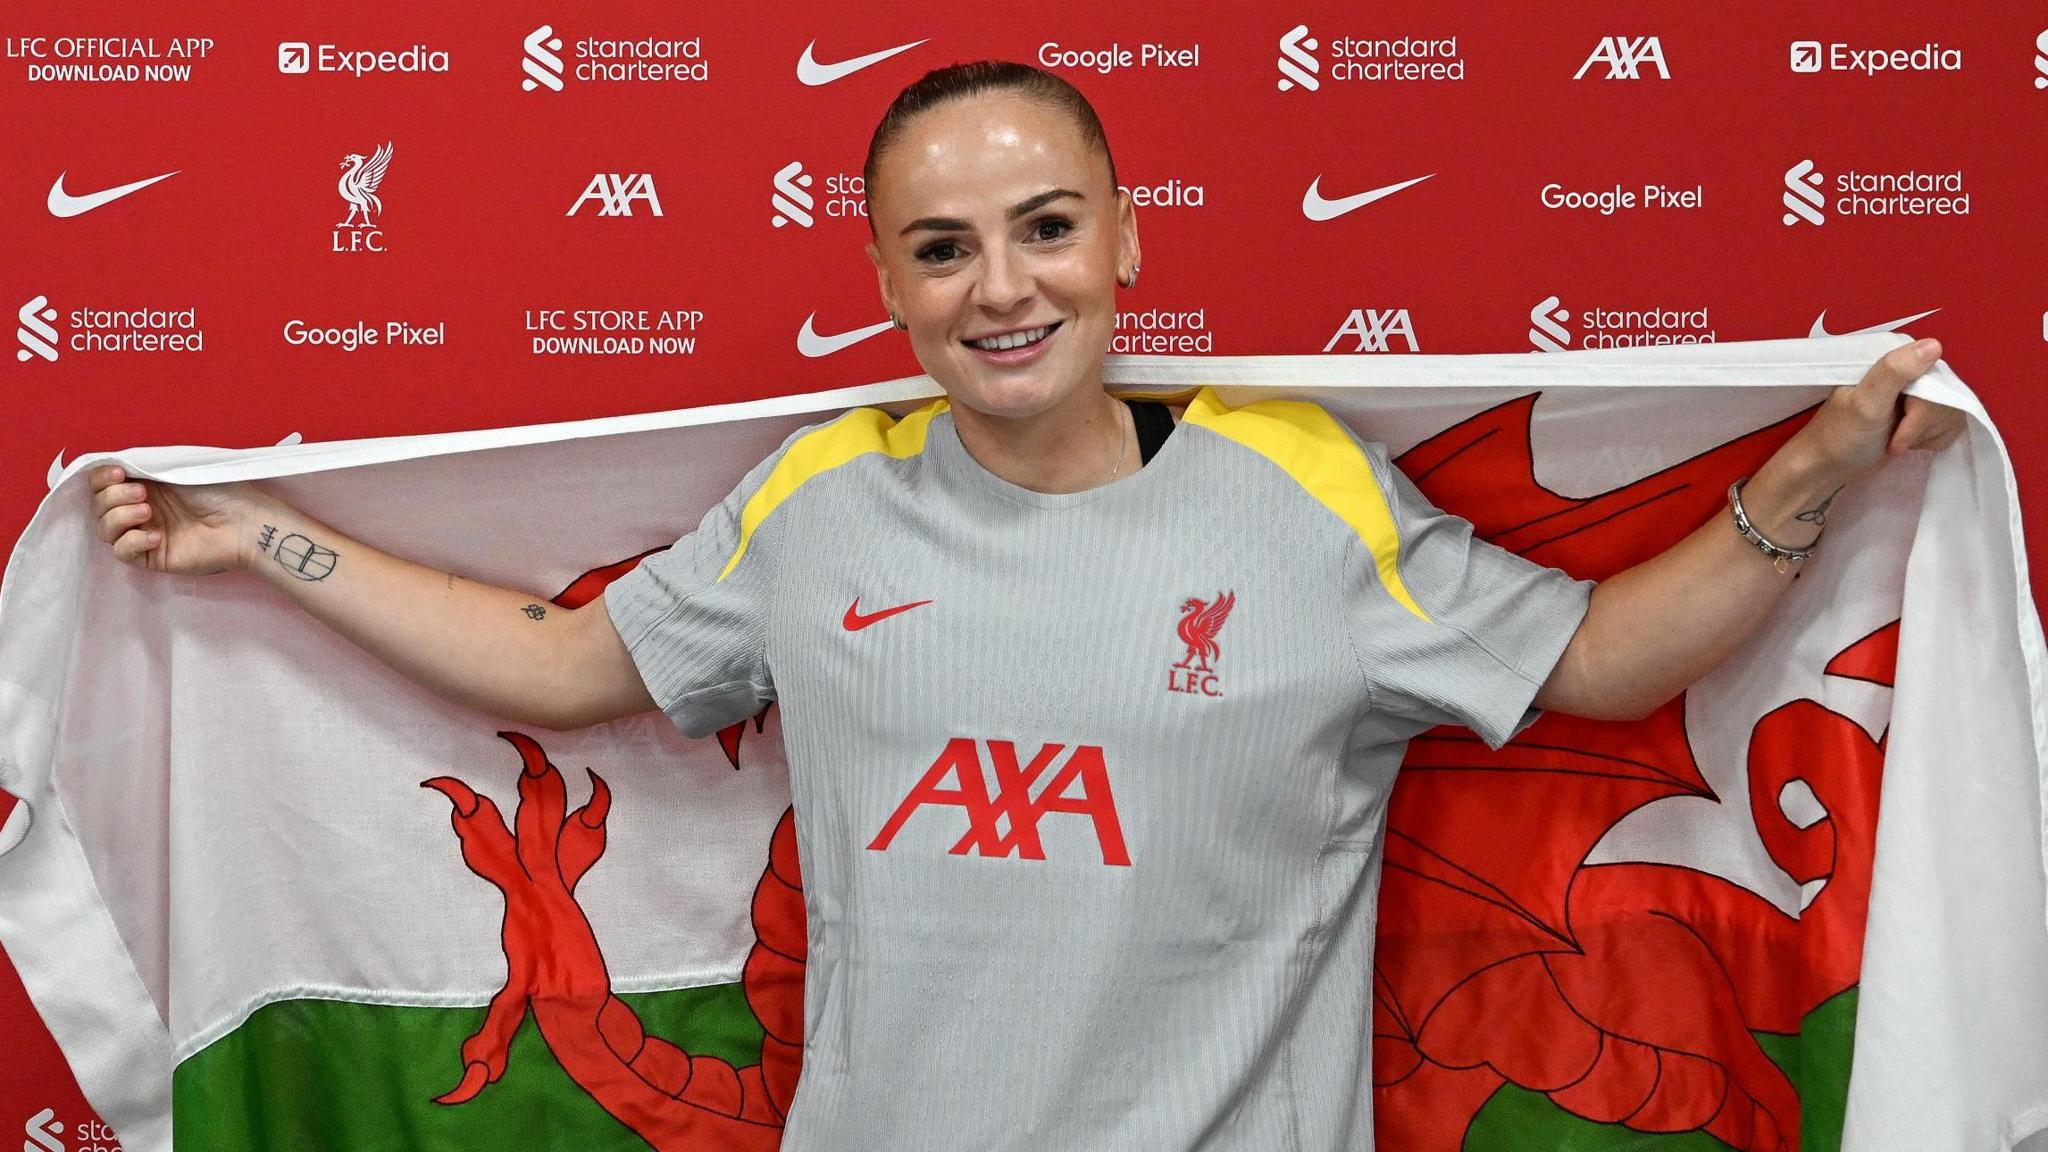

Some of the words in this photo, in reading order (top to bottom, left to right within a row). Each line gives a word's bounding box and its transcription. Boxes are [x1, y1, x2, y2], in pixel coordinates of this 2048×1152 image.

[7, 38, 46, 57] LFC
[55, 38, 160, 57] OFFICIAL
[167, 38, 213, 57] APP
[576, 37, 700, 59] standard
[1039, 43, 1133, 73] Google
[1142, 44, 1199, 66] Pixel
[1332, 36, 1456, 58] standard
[1573, 37, 1670, 79] AXA
[319, 45, 448, 77] Expedia
[576, 59, 707, 81] chartered
[1332, 59, 1463, 81] chartered
[1831, 44, 1961, 76] Expedia
[28, 65, 140, 82] DOWNLOAD
[145, 65, 191, 82] NOW
[1837, 171, 1961, 192] standard
[566, 174, 664, 216] AXA
[1117, 180, 1204, 206] edia
[1541, 184, 1635, 215] Google
[1645, 185, 1702, 208] Pixel
[1837, 193, 1969, 215] chartered
[333, 231, 387, 252] L.F.C.
[71, 308, 195, 329] standard
[526, 311, 565, 330] LFC
[573, 311, 649, 330] STORE
[657, 311, 703, 330] APP
[1583, 307, 1707, 329] standard
[71, 330, 202, 352] chartered
[284, 320, 378, 351] Google
[387, 322, 444, 344] Pixel
[1323, 309, 1420, 352] AXA
[533, 338, 644, 355] DOWNLOAD
[649, 338, 695, 355] NOW
[1107, 331, 1212, 353] artered
[1168, 669, 1223, 697] L.F.C.
[866, 738, 1131, 866] AXA
